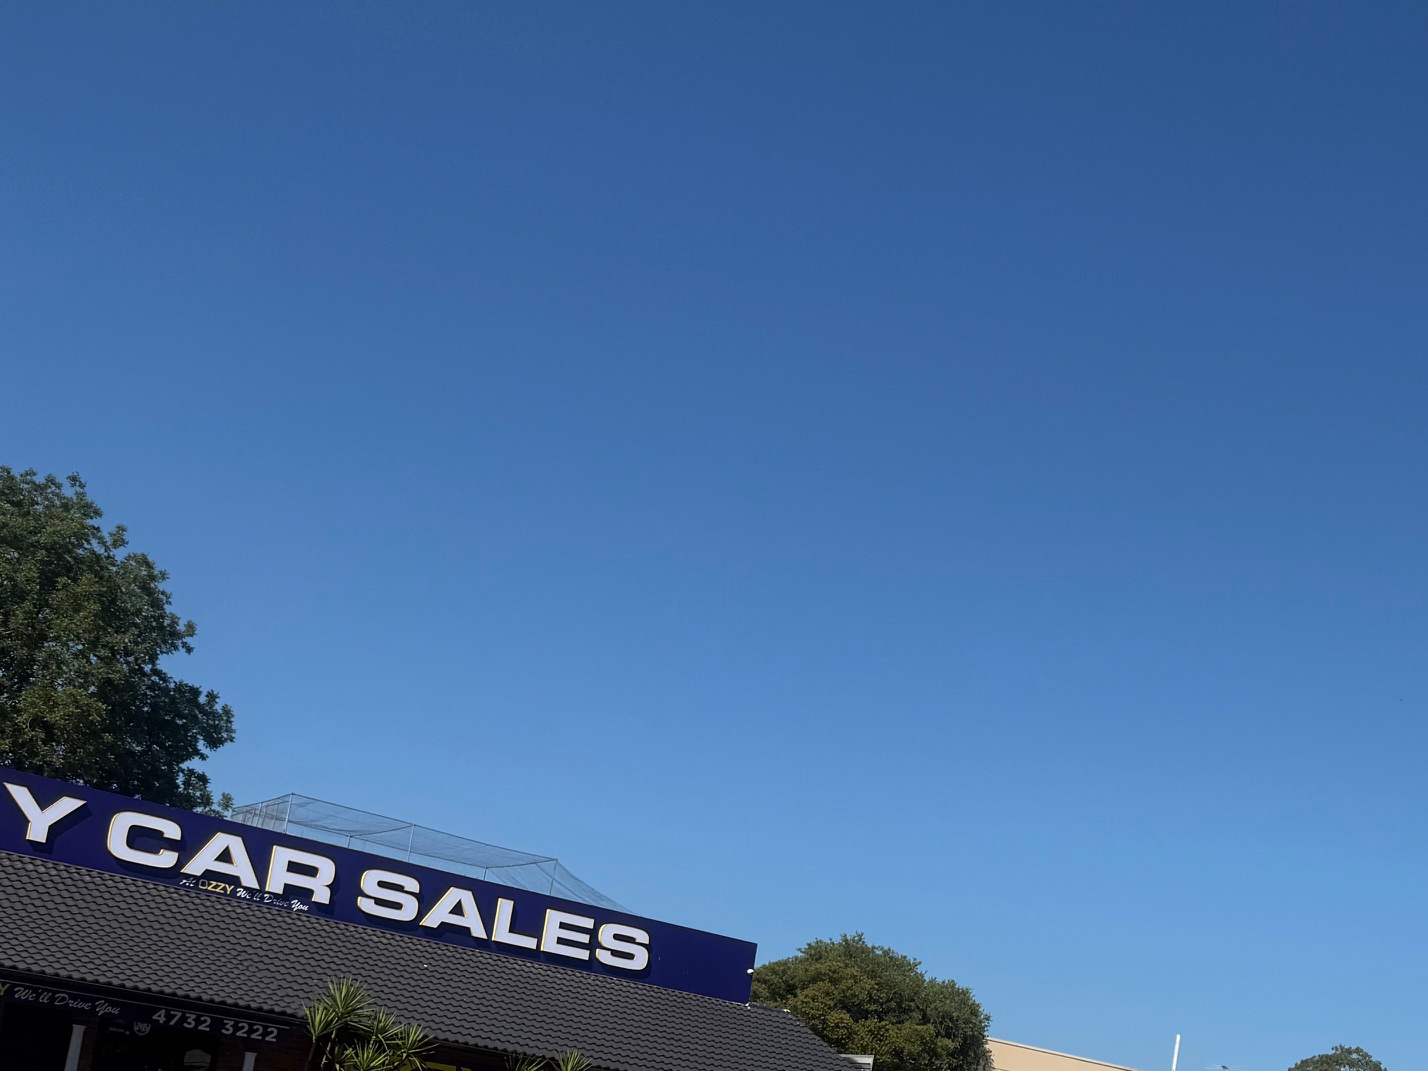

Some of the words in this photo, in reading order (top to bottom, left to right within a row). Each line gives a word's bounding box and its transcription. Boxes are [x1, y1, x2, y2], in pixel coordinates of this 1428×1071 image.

[107, 811, 337, 905] CAR
[357, 869, 650, 971] SALES
[198, 878, 235, 895] OZZY
[290, 899, 310, 912] You
[13, 986, 51, 1004] We'll
[54, 993, 92, 1010] Drive
[94, 999, 121, 1016] You
[152, 1008, 212, 1032] 4732
[220, 1019, 279, 1042] 3222
